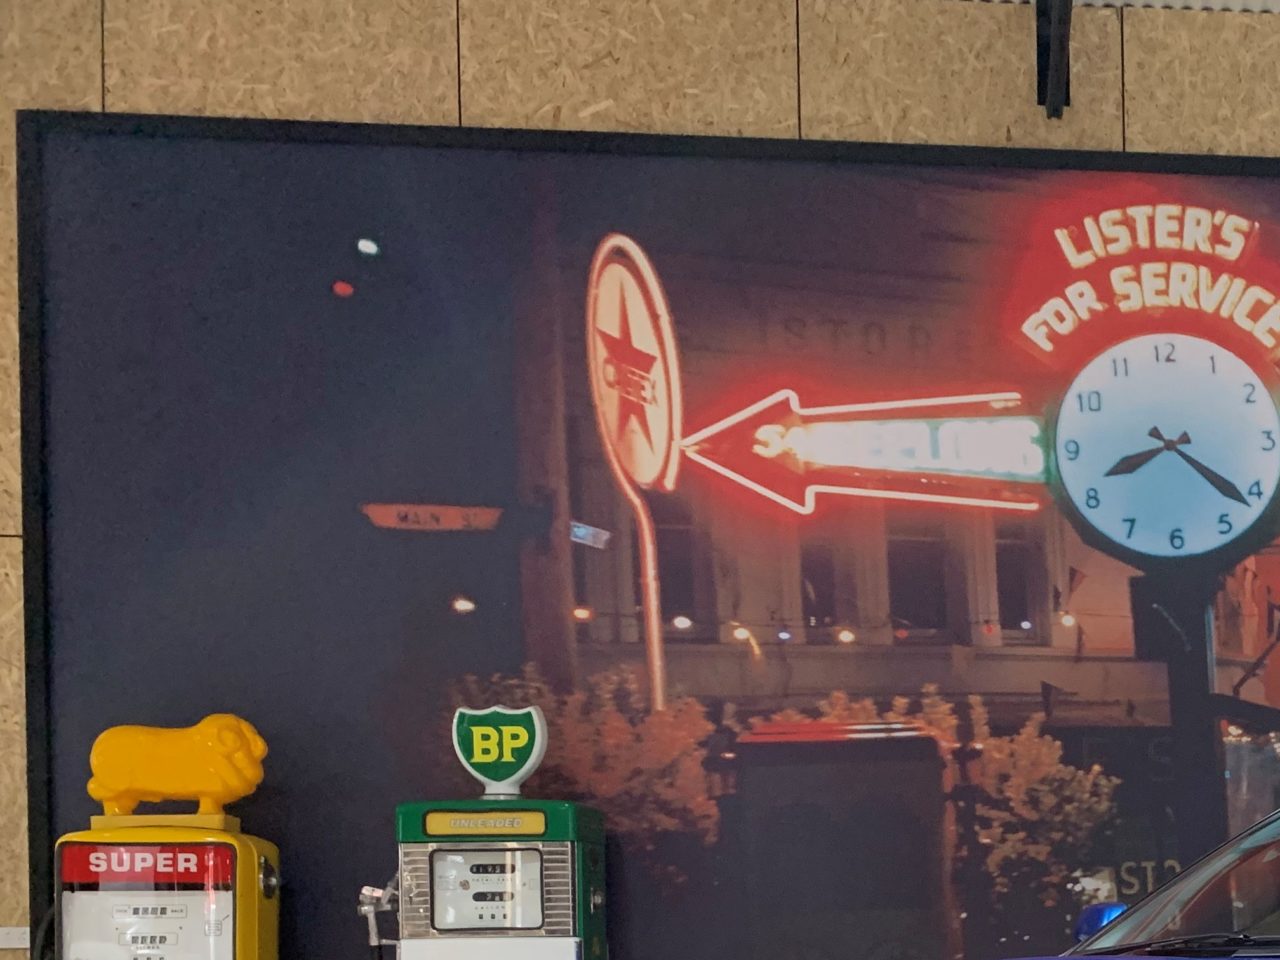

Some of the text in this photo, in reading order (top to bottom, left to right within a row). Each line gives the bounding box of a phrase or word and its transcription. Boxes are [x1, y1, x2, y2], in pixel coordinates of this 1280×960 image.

[1054, 203, 1250, 268] LISTER'S
[1020, 280, 1104, 352] FOR
[1154, 342, 1176, 363] 12
[1112, 357, 1129, 377] 11
[1209, 355, 1217, 374] 1
[1077, 391, 1101, 412] 10
[1243, 383, 1256, 404] 2
[1064, 440, 1080, 461] 9
[1261, 430, 1276, 451] 3
[1086, 488, 1100, 509] 8
[1248, 480, 1263, 500] 4
[1122, 518, 1137, 539] 7
[1217, 514, 1233, 534] 5
[1169, 528, 1185, 550] 6
[469, 725, 529, 763] BP
[450, 817, 523, 829] UNLEADED
[88, 852, 198, 873] SUPER
